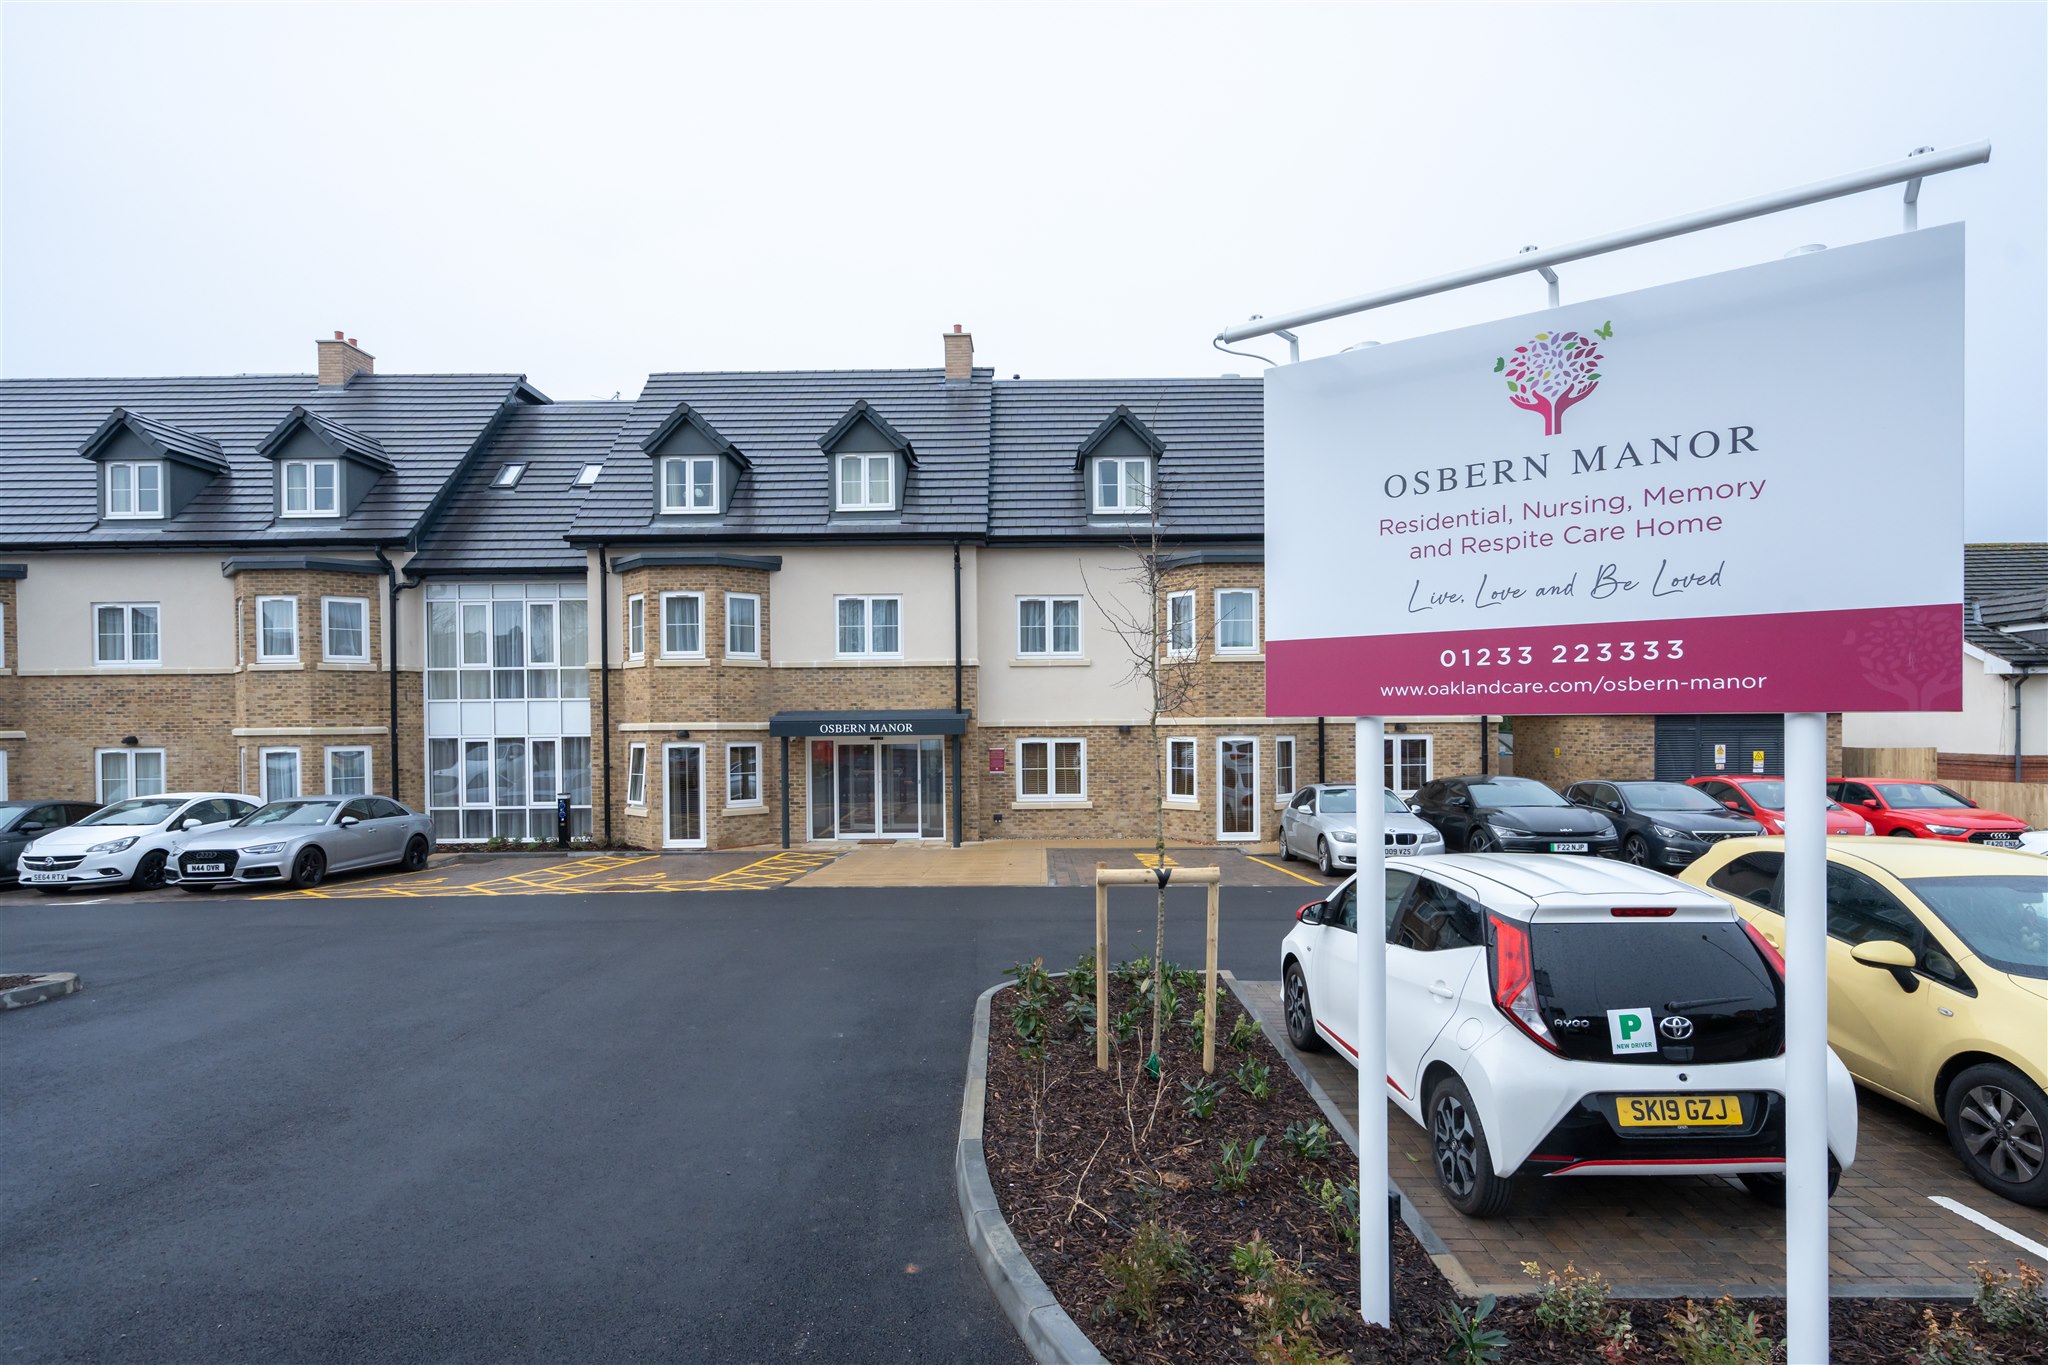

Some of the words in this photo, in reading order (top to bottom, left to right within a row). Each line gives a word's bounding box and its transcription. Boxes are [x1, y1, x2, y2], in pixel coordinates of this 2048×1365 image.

[1383, 453, 1551, 499] OSBERN
[1571, 425, 1760, 475] MANOR
[1379, 505, 1513, 537] Residential,
[1523, 495, 1632, 521] Nursing,
[1644, 480, 1767, 508] Memory
[1409, 538, 1452, 560] and
[1461, 531, 1554, 555] Respite
[1563, 526, 1626, 545] Care
[1636, 516, 1723, 539] Home
[1407, 579, 1465, 614] Live,
[1474, 573, 1528, 609] Love
[1535, 571, 1578, 598] and
[1590, 563, 1640, 600] Be
[1651, 558, 1726, 598] Loved
[1439, 646, 1533, 668] 01233
[1551, 639, 1684, 664] 223333
[1379, 675, 1768, 698] www.oaklandcare.com/osbern-manor
[819, 723, 866, 734] OSBERN
[869, 723, 913, 733] MANOR
[191, 864, 206, 872] N44
[1554, 1018, 1590, 1028] AYGO
[1618, 1014, 1643, 1041] P
[1631, 1041, 1653, 1049] DRIVER
[1630, 1099, 1681, 1121] SK19
[1684, 1098, 1728, 1121] GZJ
